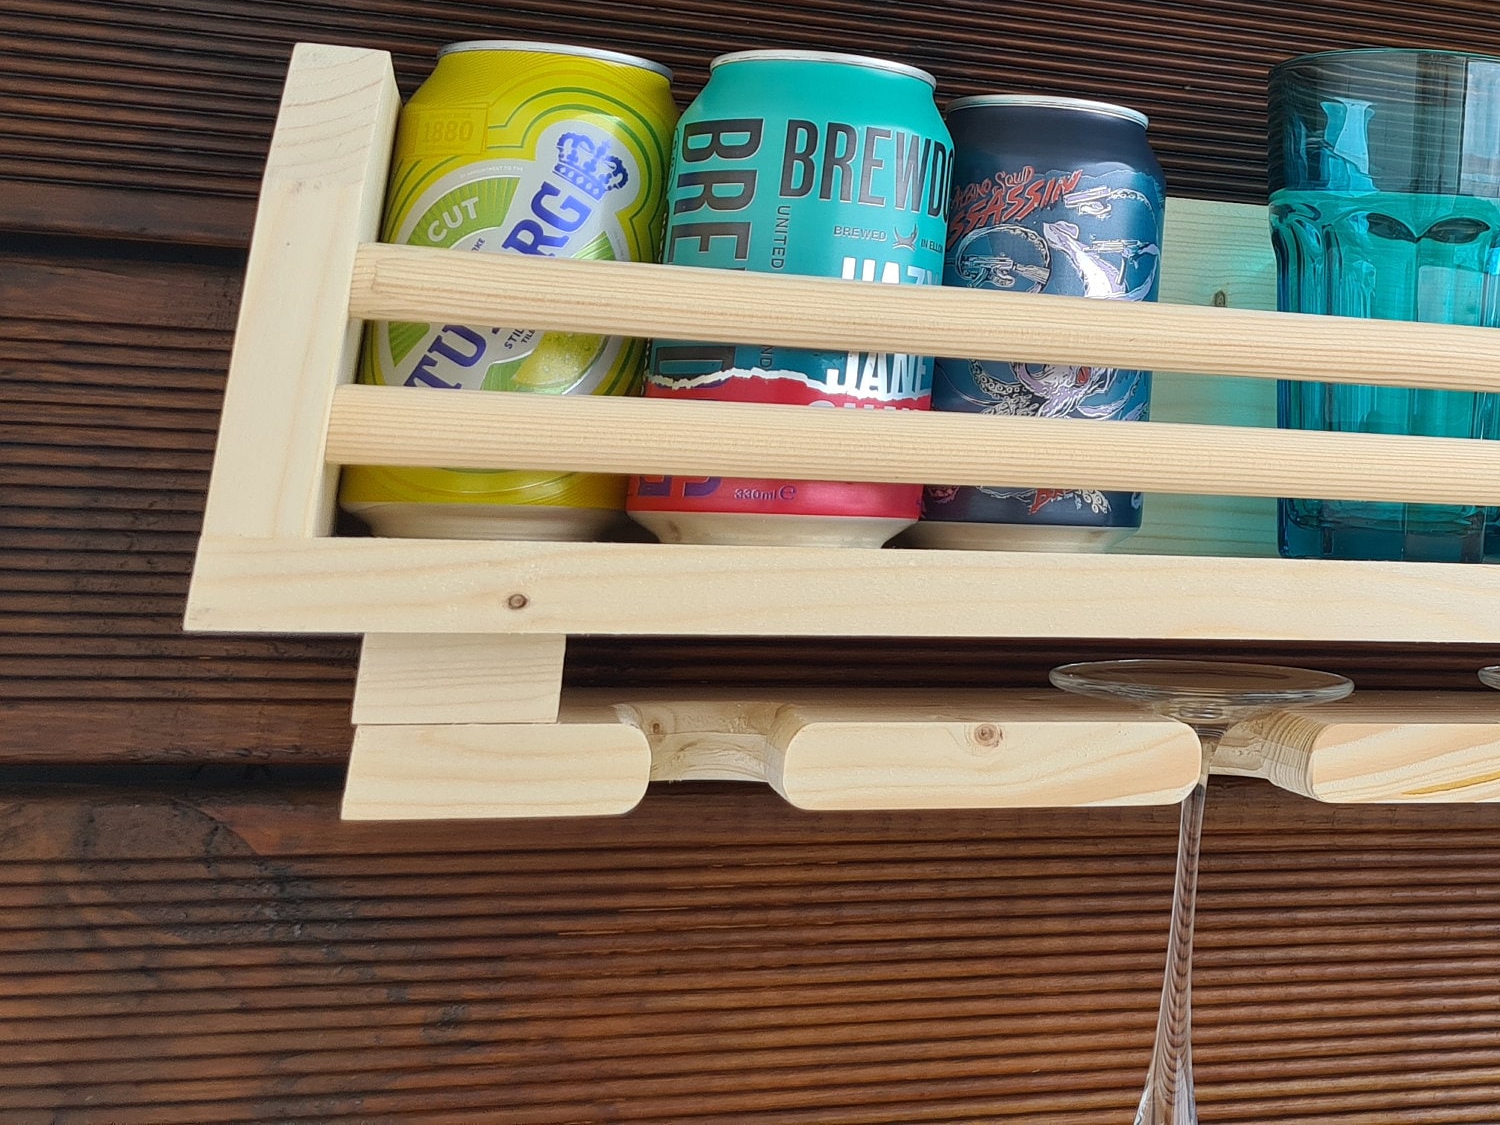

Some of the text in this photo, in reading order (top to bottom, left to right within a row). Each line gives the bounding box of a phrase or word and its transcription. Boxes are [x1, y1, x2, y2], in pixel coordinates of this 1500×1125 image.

[427, 196, 479, 243] CUT
[771, 205, 792, 269] UNITED
[833, 225, 888, 242] BREWED
